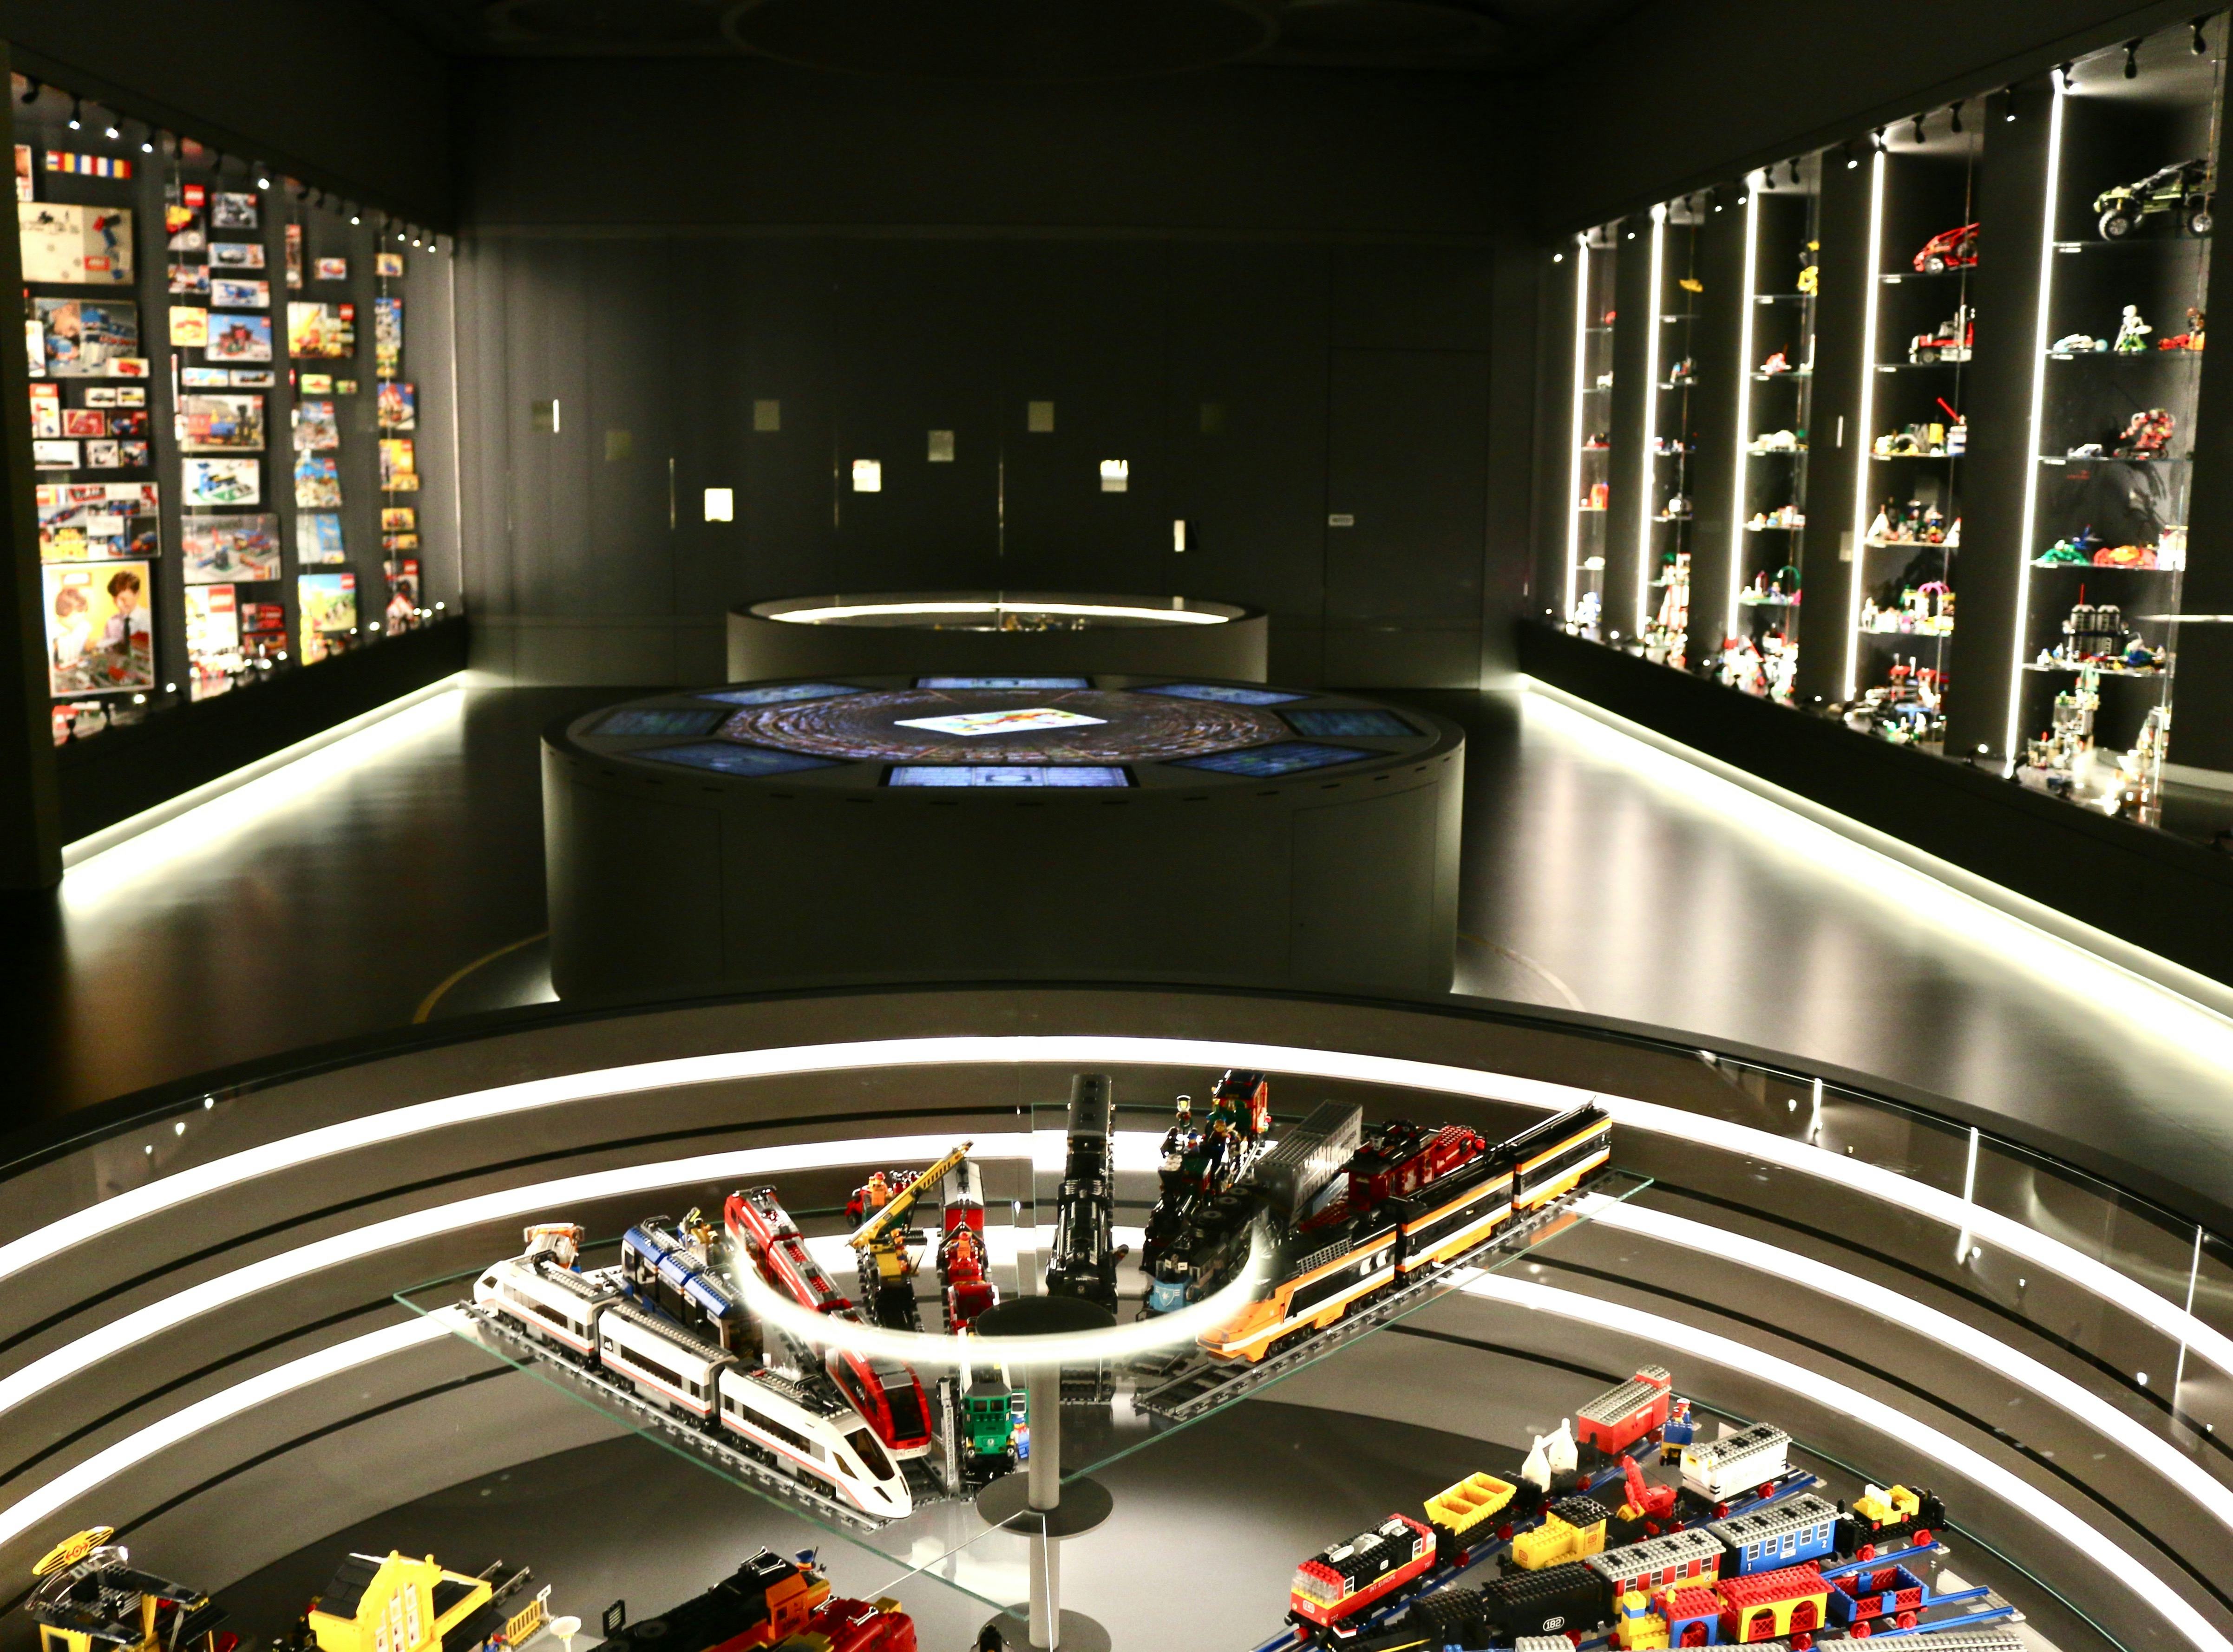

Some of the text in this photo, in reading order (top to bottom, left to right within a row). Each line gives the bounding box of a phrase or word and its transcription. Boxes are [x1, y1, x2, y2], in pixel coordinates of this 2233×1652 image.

[1821, 1540, 1827, 1548] 2
[1747, 1563, 1752, 1571] 1
[1546, 1619, 1561, 1629] 182
